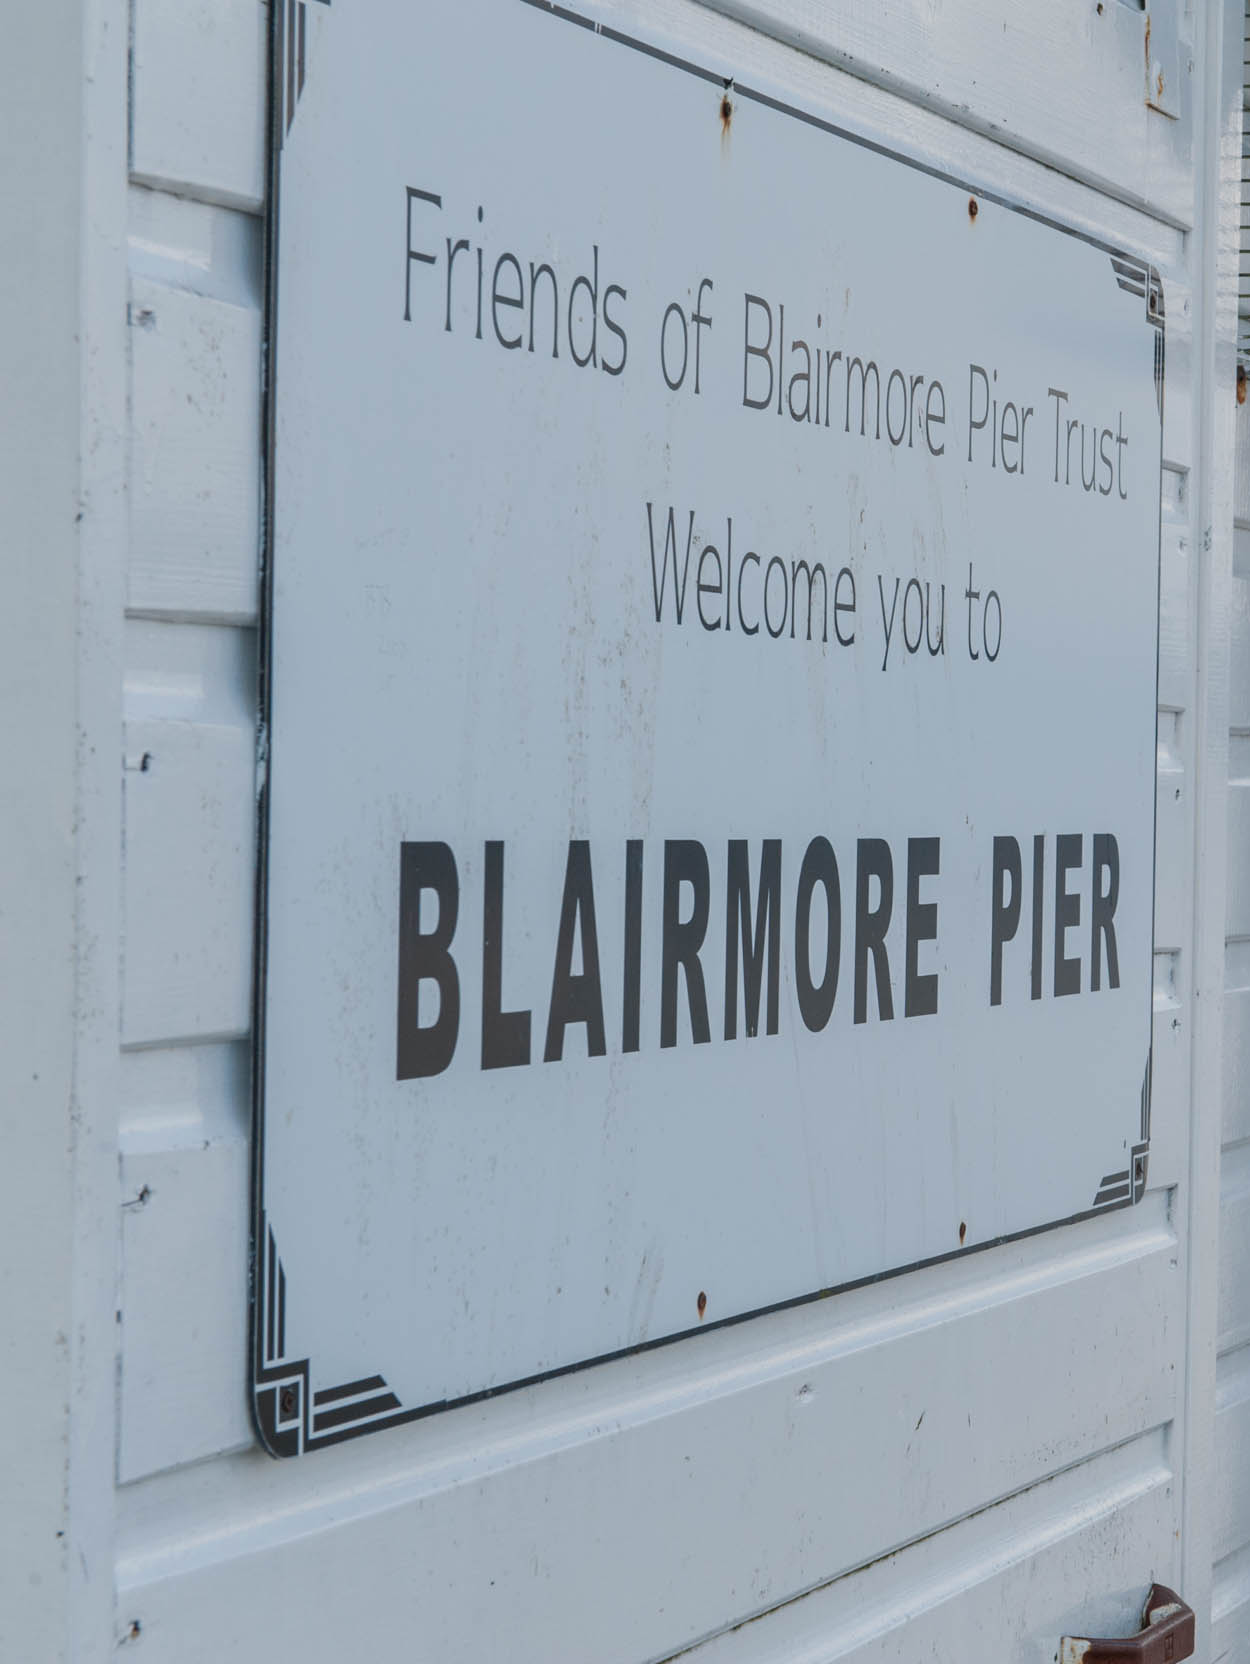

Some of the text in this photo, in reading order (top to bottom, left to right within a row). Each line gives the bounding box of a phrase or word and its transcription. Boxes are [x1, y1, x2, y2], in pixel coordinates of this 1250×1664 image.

[402, 186, 1129, 501] Friends of Blairmore Pier Trust
[645, 502, 1003, 672] Welcome you to
[395, 832, 1121, 1082] BLAIRMORE PIER
